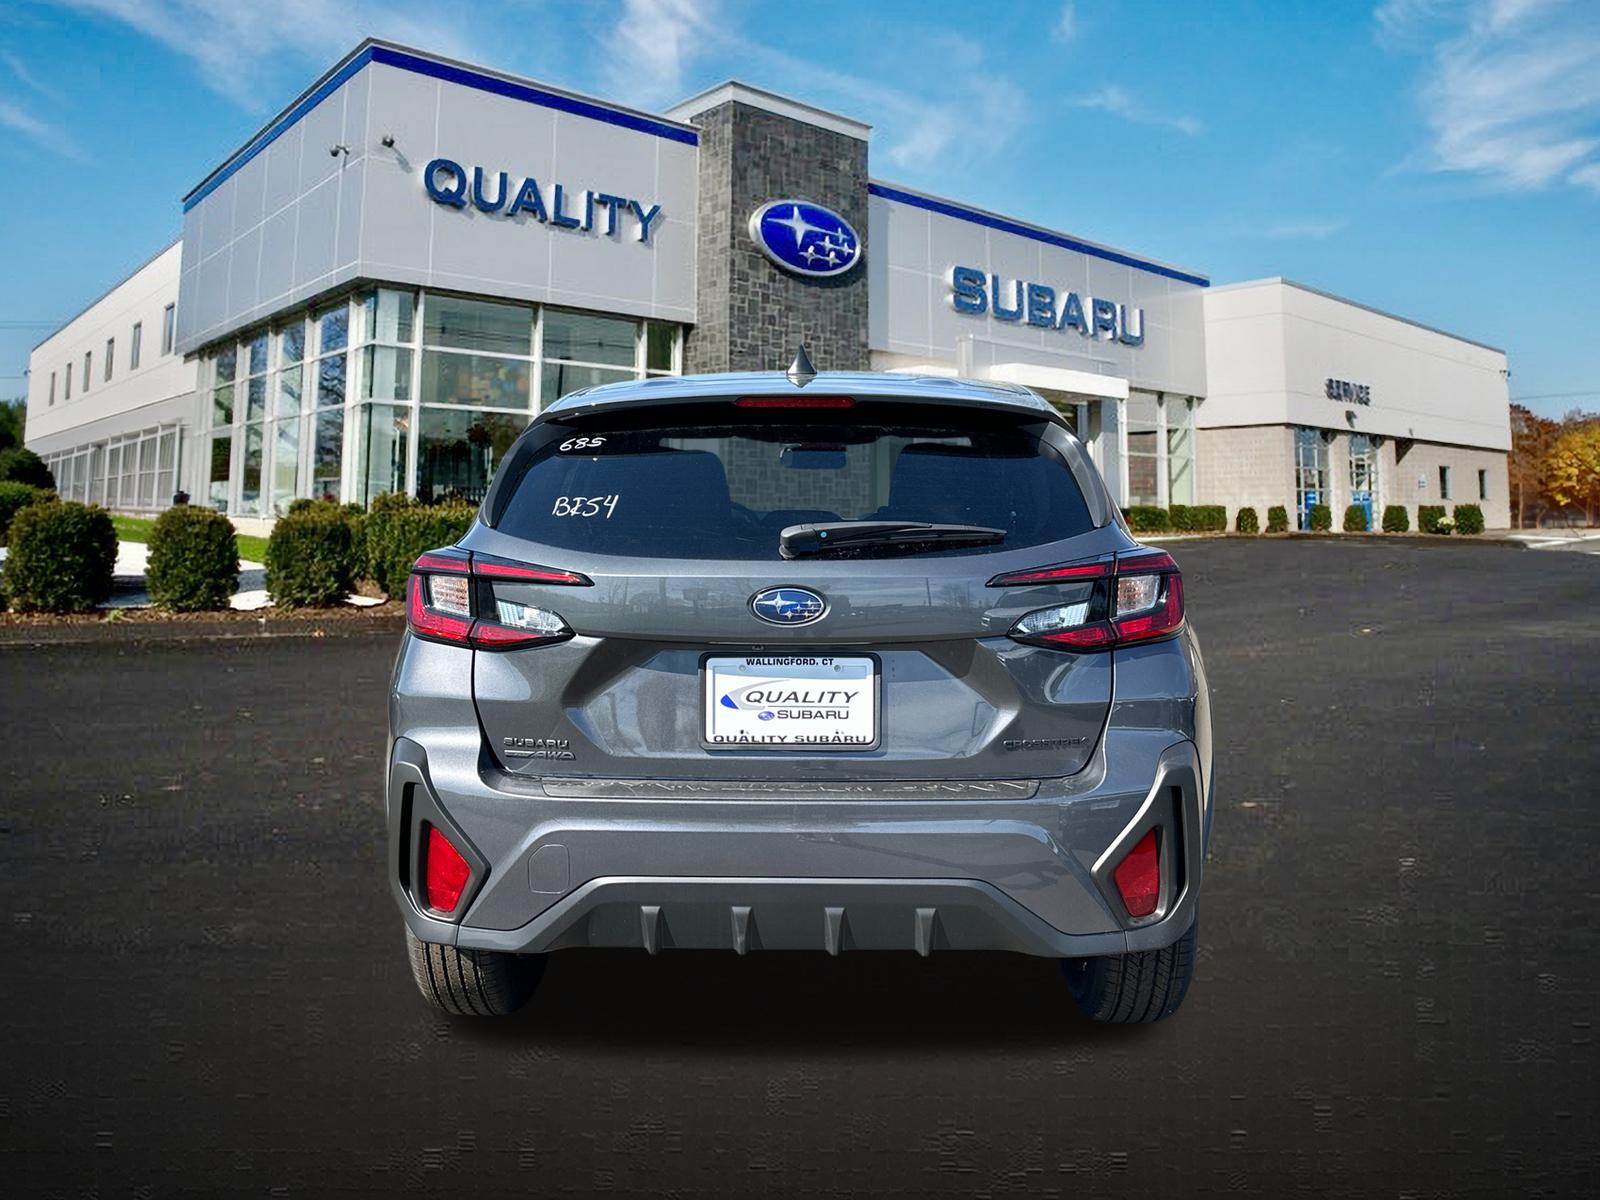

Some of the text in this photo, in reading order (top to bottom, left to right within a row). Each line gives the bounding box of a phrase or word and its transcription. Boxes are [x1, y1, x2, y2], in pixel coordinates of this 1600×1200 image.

[424, 158, 662, 243] QUALITY
[950, 265, 1145, 347] SUBARU
[559, 437, 607, 452] 685
[821, 657, 834, 667] CT
[745, 690, 860, 704] QUALITY
[776, 709, 850, 720] SUBARU
[503, 736, 569, 750] SUBARU
[712, 734, 867, 744] QUALITY SUBARU
[530, 750, 577, 761] AWD
